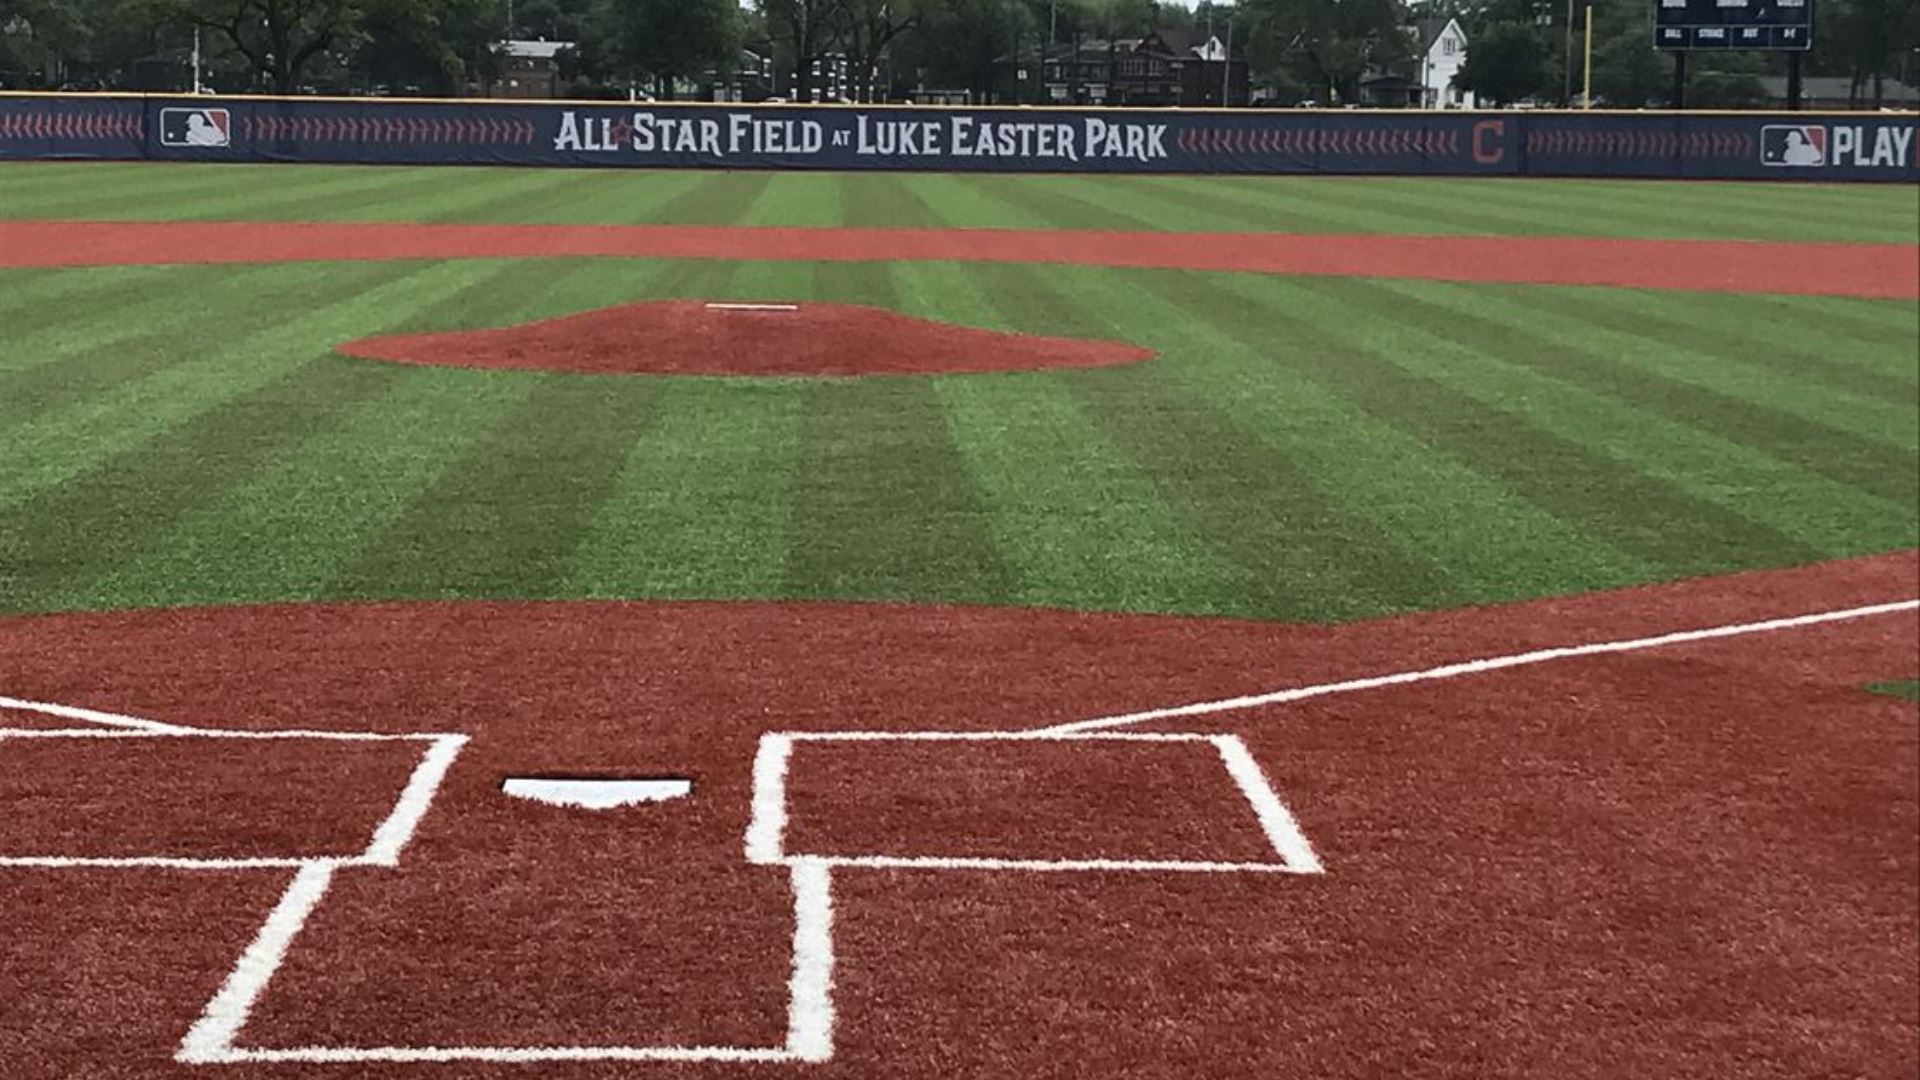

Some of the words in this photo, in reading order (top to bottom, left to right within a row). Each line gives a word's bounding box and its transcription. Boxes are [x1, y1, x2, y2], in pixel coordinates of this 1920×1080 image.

[554, 112, 618, 151] ALL
[633, 112, 723, 157] STAR
[728, 113, 822, 153] FIELD
[832, 130, 851, 146] AT
[856, 115, 941, 155] LUKE
[951, 116, 1079, 161] EASTER
[1084, 117, 1168, 162] PARK
[1472, 120, 1504, 163] C
[1833, 126, 1914, 167] PLAY
